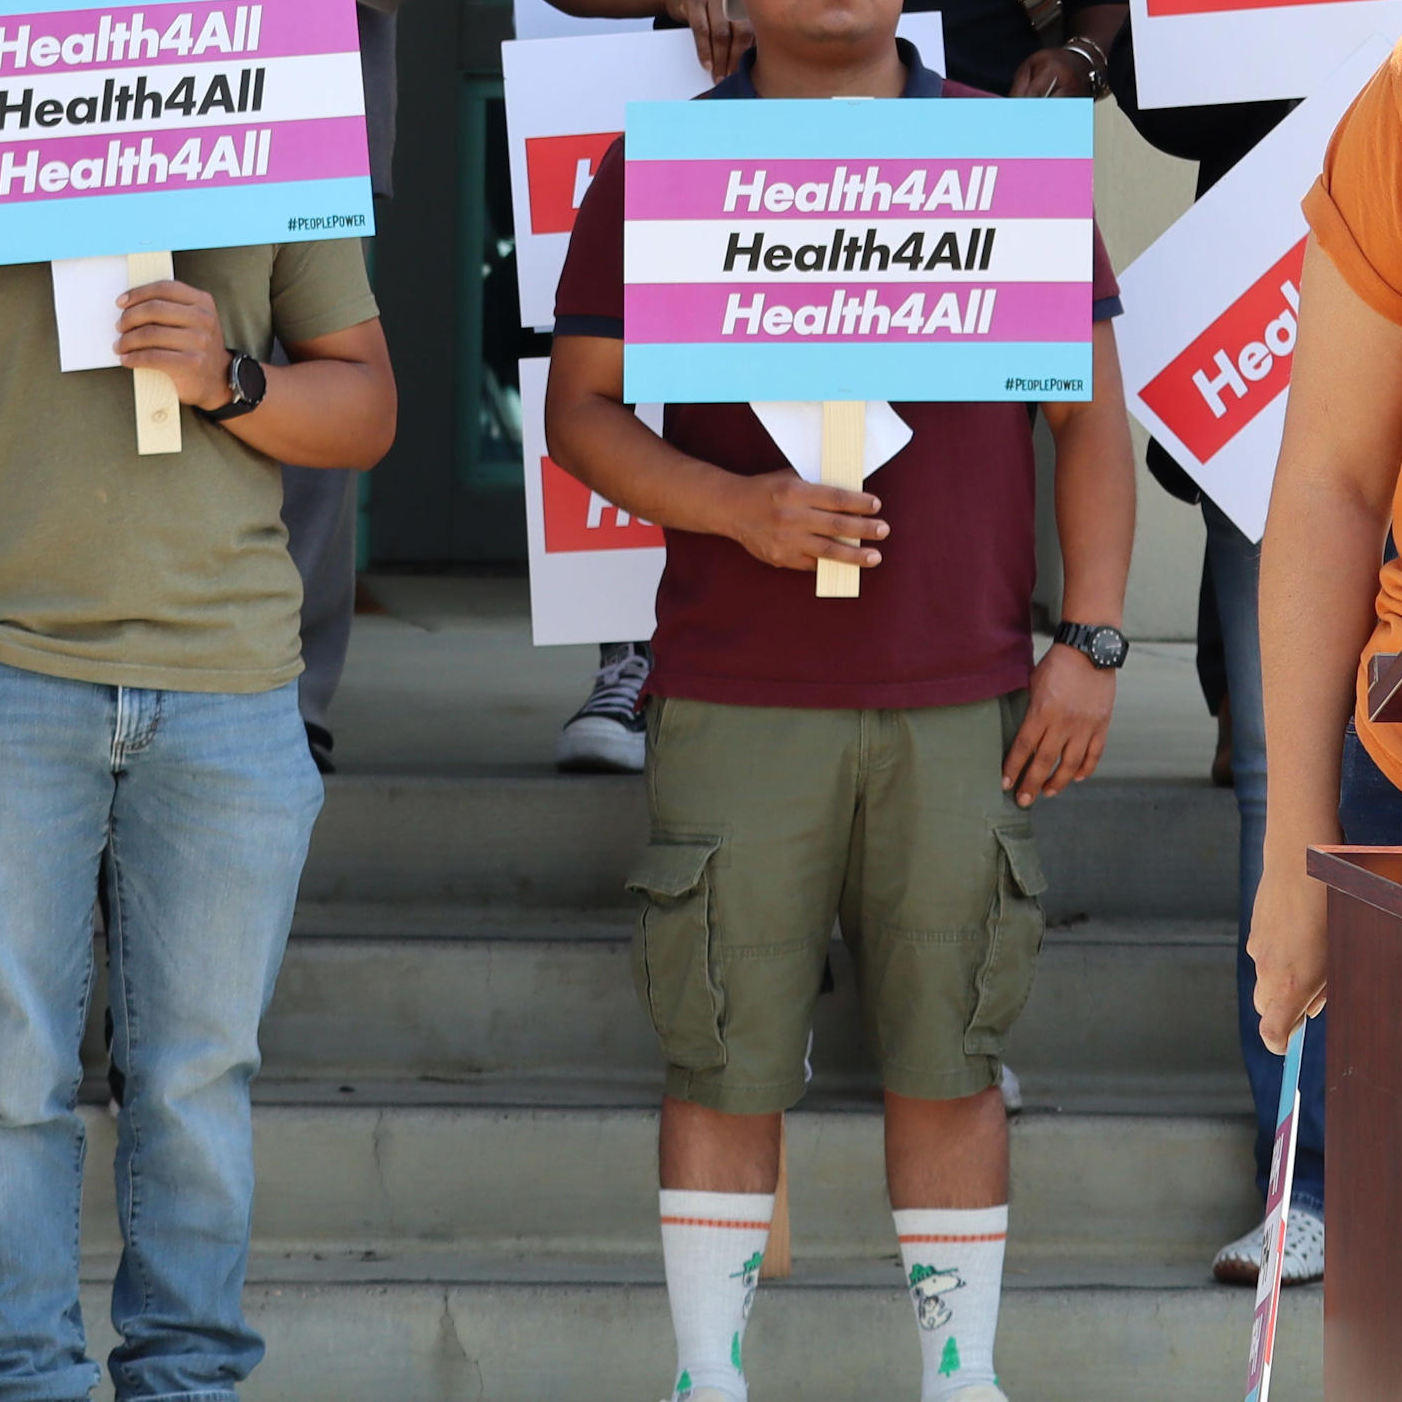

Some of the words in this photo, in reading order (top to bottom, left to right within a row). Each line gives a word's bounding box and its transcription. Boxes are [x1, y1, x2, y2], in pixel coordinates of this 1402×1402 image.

[722, 164, 999, 213] Health4All
[287, 213, 366, 232] #PEOPLEPOWER
[722, 228, 997, 272] Health4All
[721, 288, 998, 336] Health4All
[1004, 376, 1085, 393] #PEOPLEPOWER
